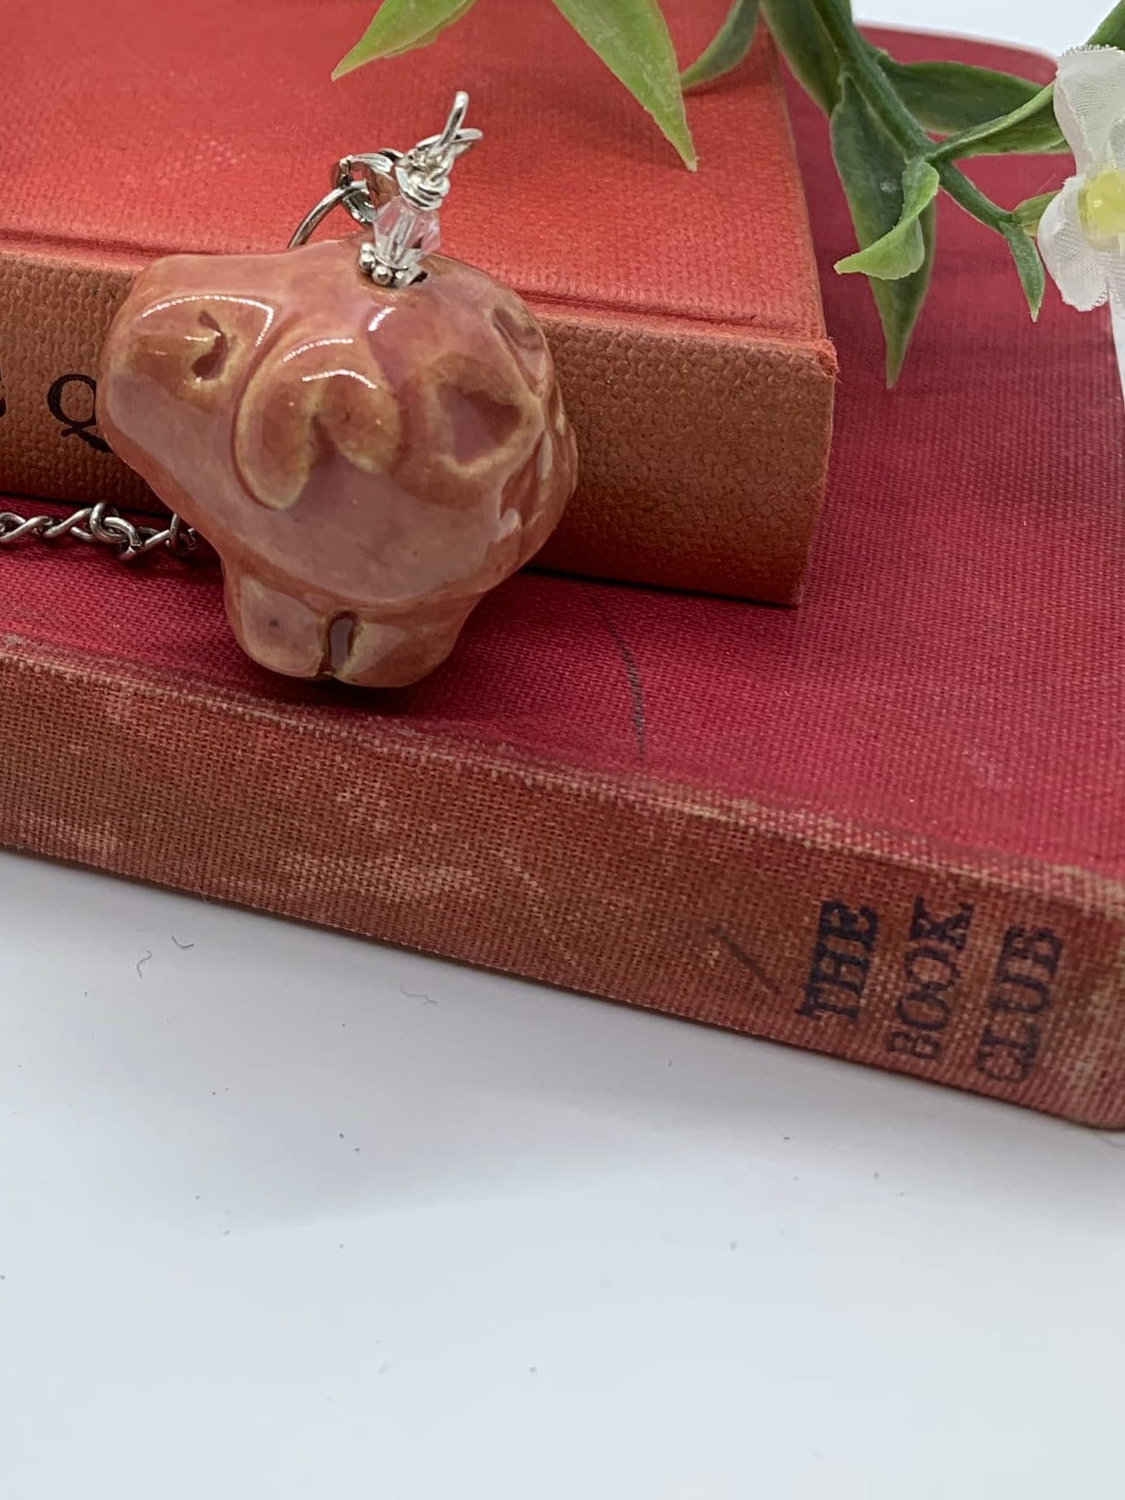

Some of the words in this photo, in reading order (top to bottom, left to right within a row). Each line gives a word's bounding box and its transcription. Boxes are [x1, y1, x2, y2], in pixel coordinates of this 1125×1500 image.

[794, 901, 879, 1023] THE
[885, 896, 974, 1060] BOOK
[976, 926, 1063, 1082] CLUB
